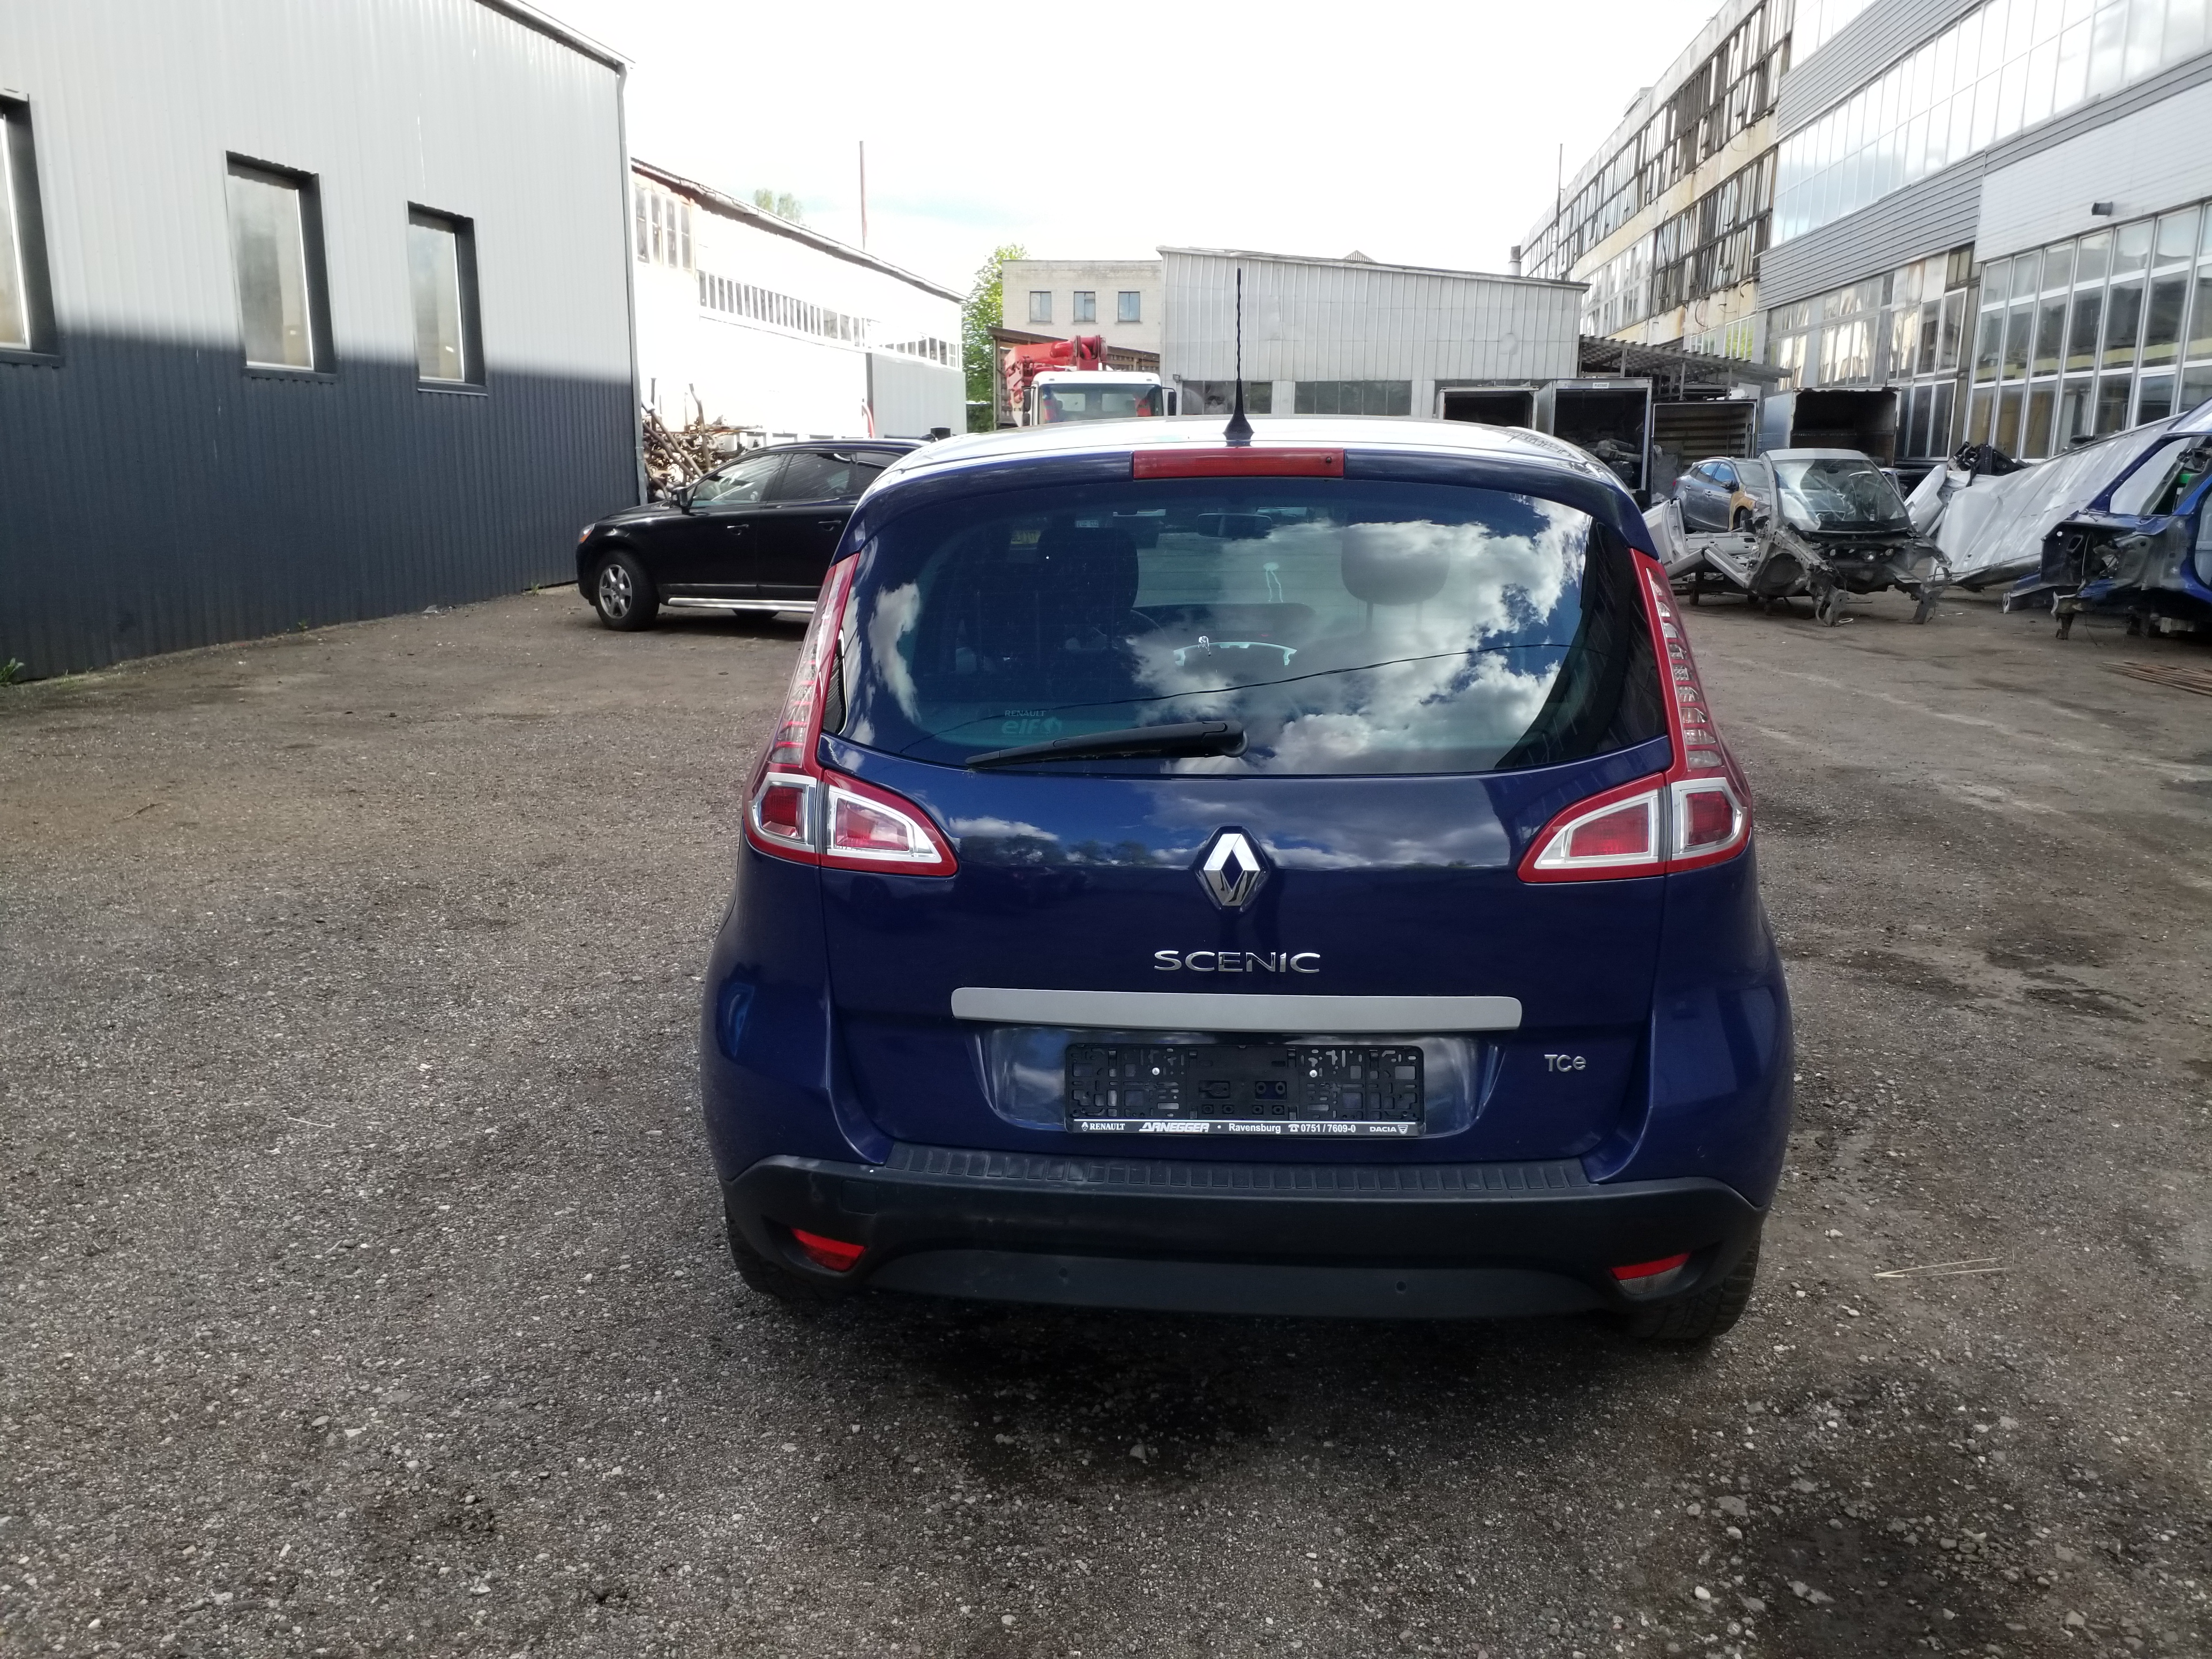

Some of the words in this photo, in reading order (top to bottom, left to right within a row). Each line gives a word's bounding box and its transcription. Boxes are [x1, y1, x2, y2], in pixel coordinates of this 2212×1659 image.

[1001, 719, 1040, 734] elf
[1154, 950, 1320, 973] SCENIC
[1544, 1054, 1587, 1072] TCe
[1089, 1123, 1125, 1131] RENAULT
[1139, 1122, 1210, 1133] ARNEGGER
[1229, 1123, 1281, 1134] Ravensburg
